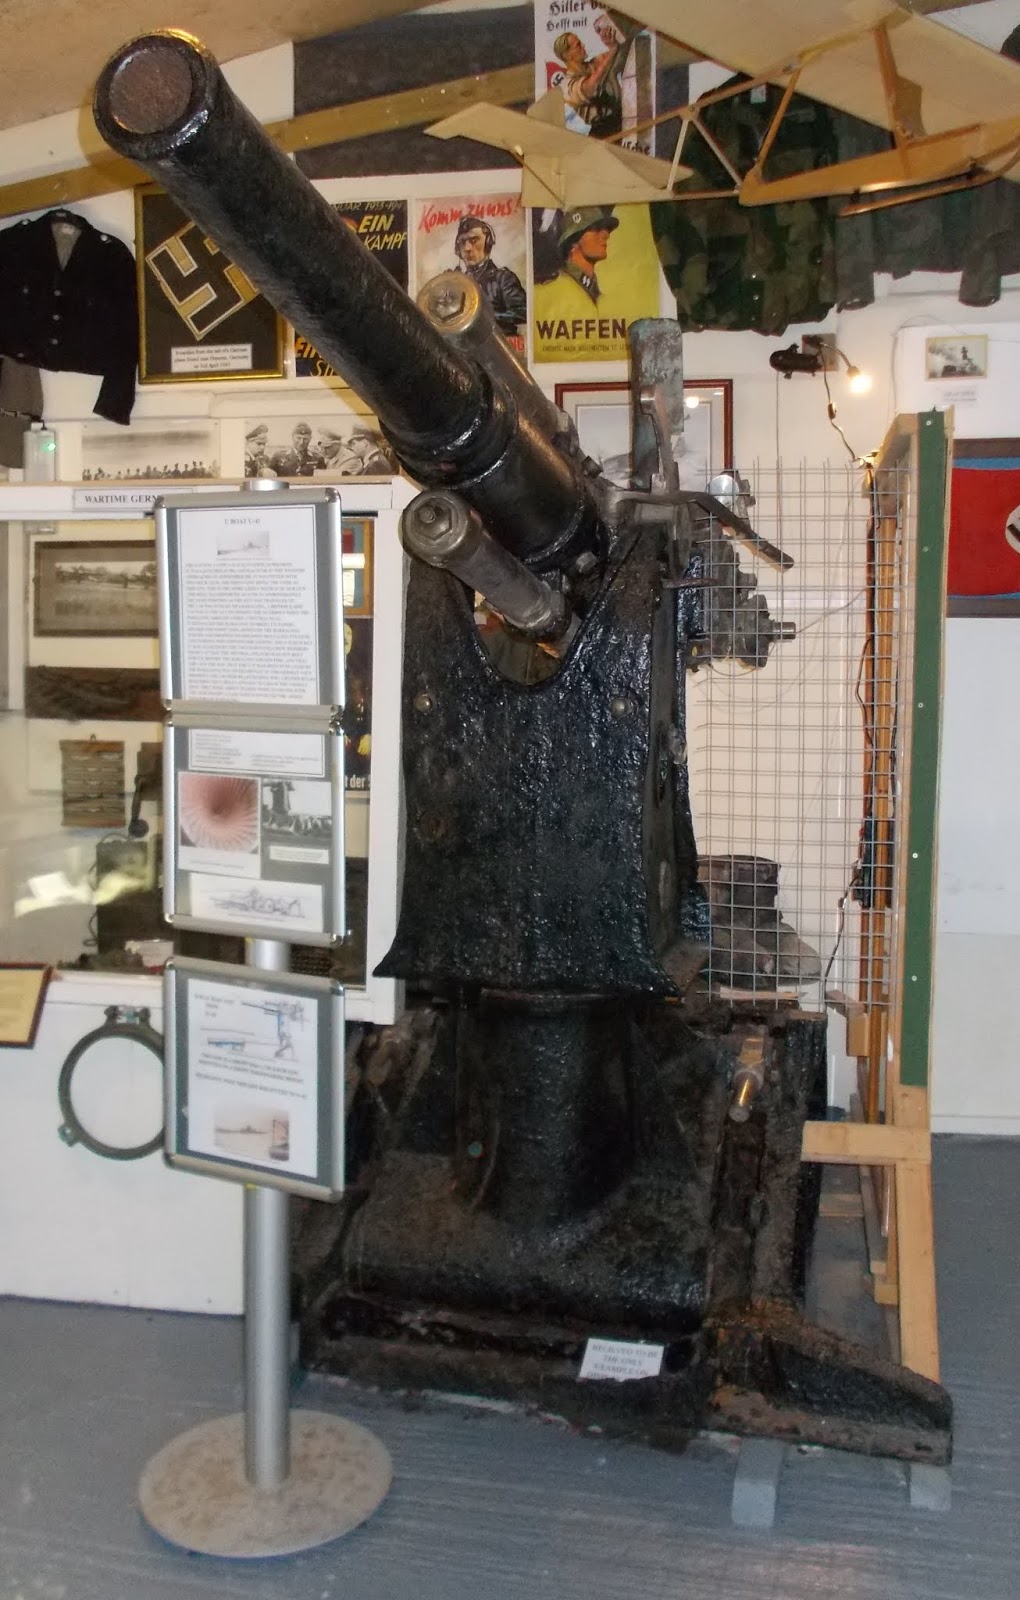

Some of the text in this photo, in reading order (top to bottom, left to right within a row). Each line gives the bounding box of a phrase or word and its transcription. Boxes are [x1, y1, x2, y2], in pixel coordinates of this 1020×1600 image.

[358, 214, 394, 233] EIN
[417, 204, 463, 234] Komm
[363, 232, 407, 251] KAMPF
[84, 494, 128, 504] WARTIME
[350, 774, 366, 789] der
